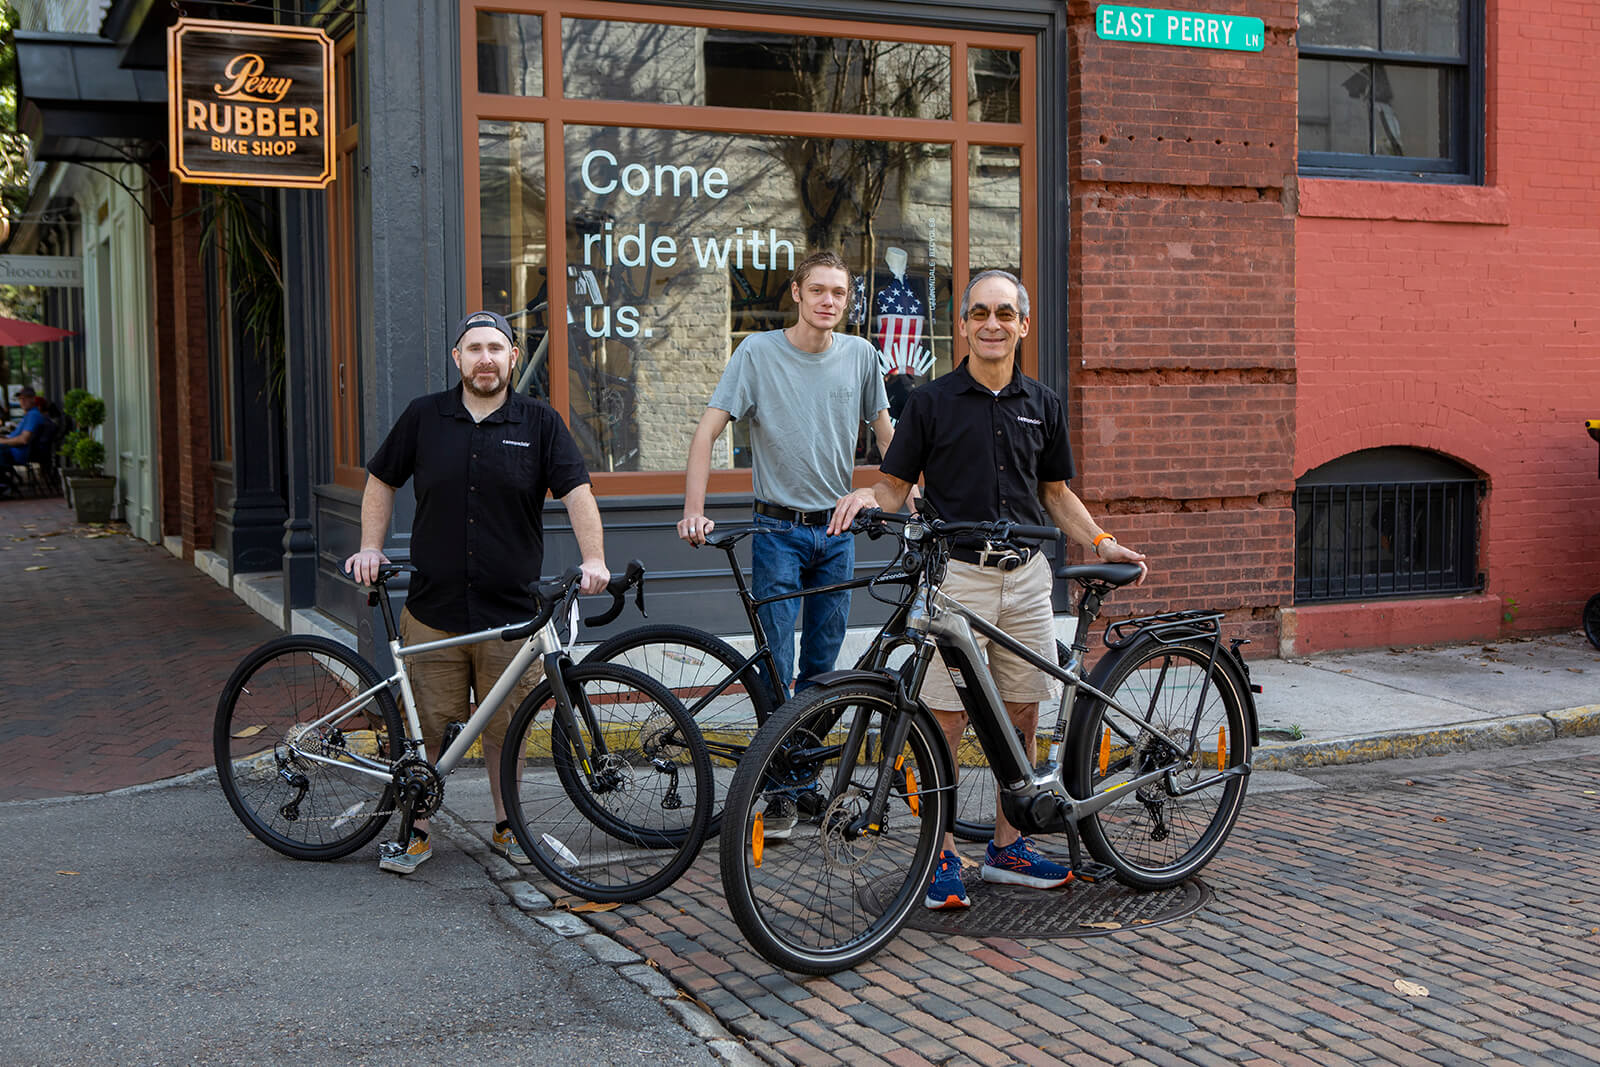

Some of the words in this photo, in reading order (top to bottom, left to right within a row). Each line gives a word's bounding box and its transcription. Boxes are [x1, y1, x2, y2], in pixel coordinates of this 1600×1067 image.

[1103, 10, 1154, 38] EAST
[1168, 16, 1233, 44] PERRY
[1245, 34, 1259, 47] LN
[213, 53, 293, 103] Perry
[187, 98, 319, 137] RUBBER
[211, 136, 248, 155] BIKE
[251, 140, 297, 156] SHOP
[581, 149, 729, 199] Come
[583, 222, 677, 268] ride
[691, 227, 795, 271] with
[584, 305, 653, 338] us.
